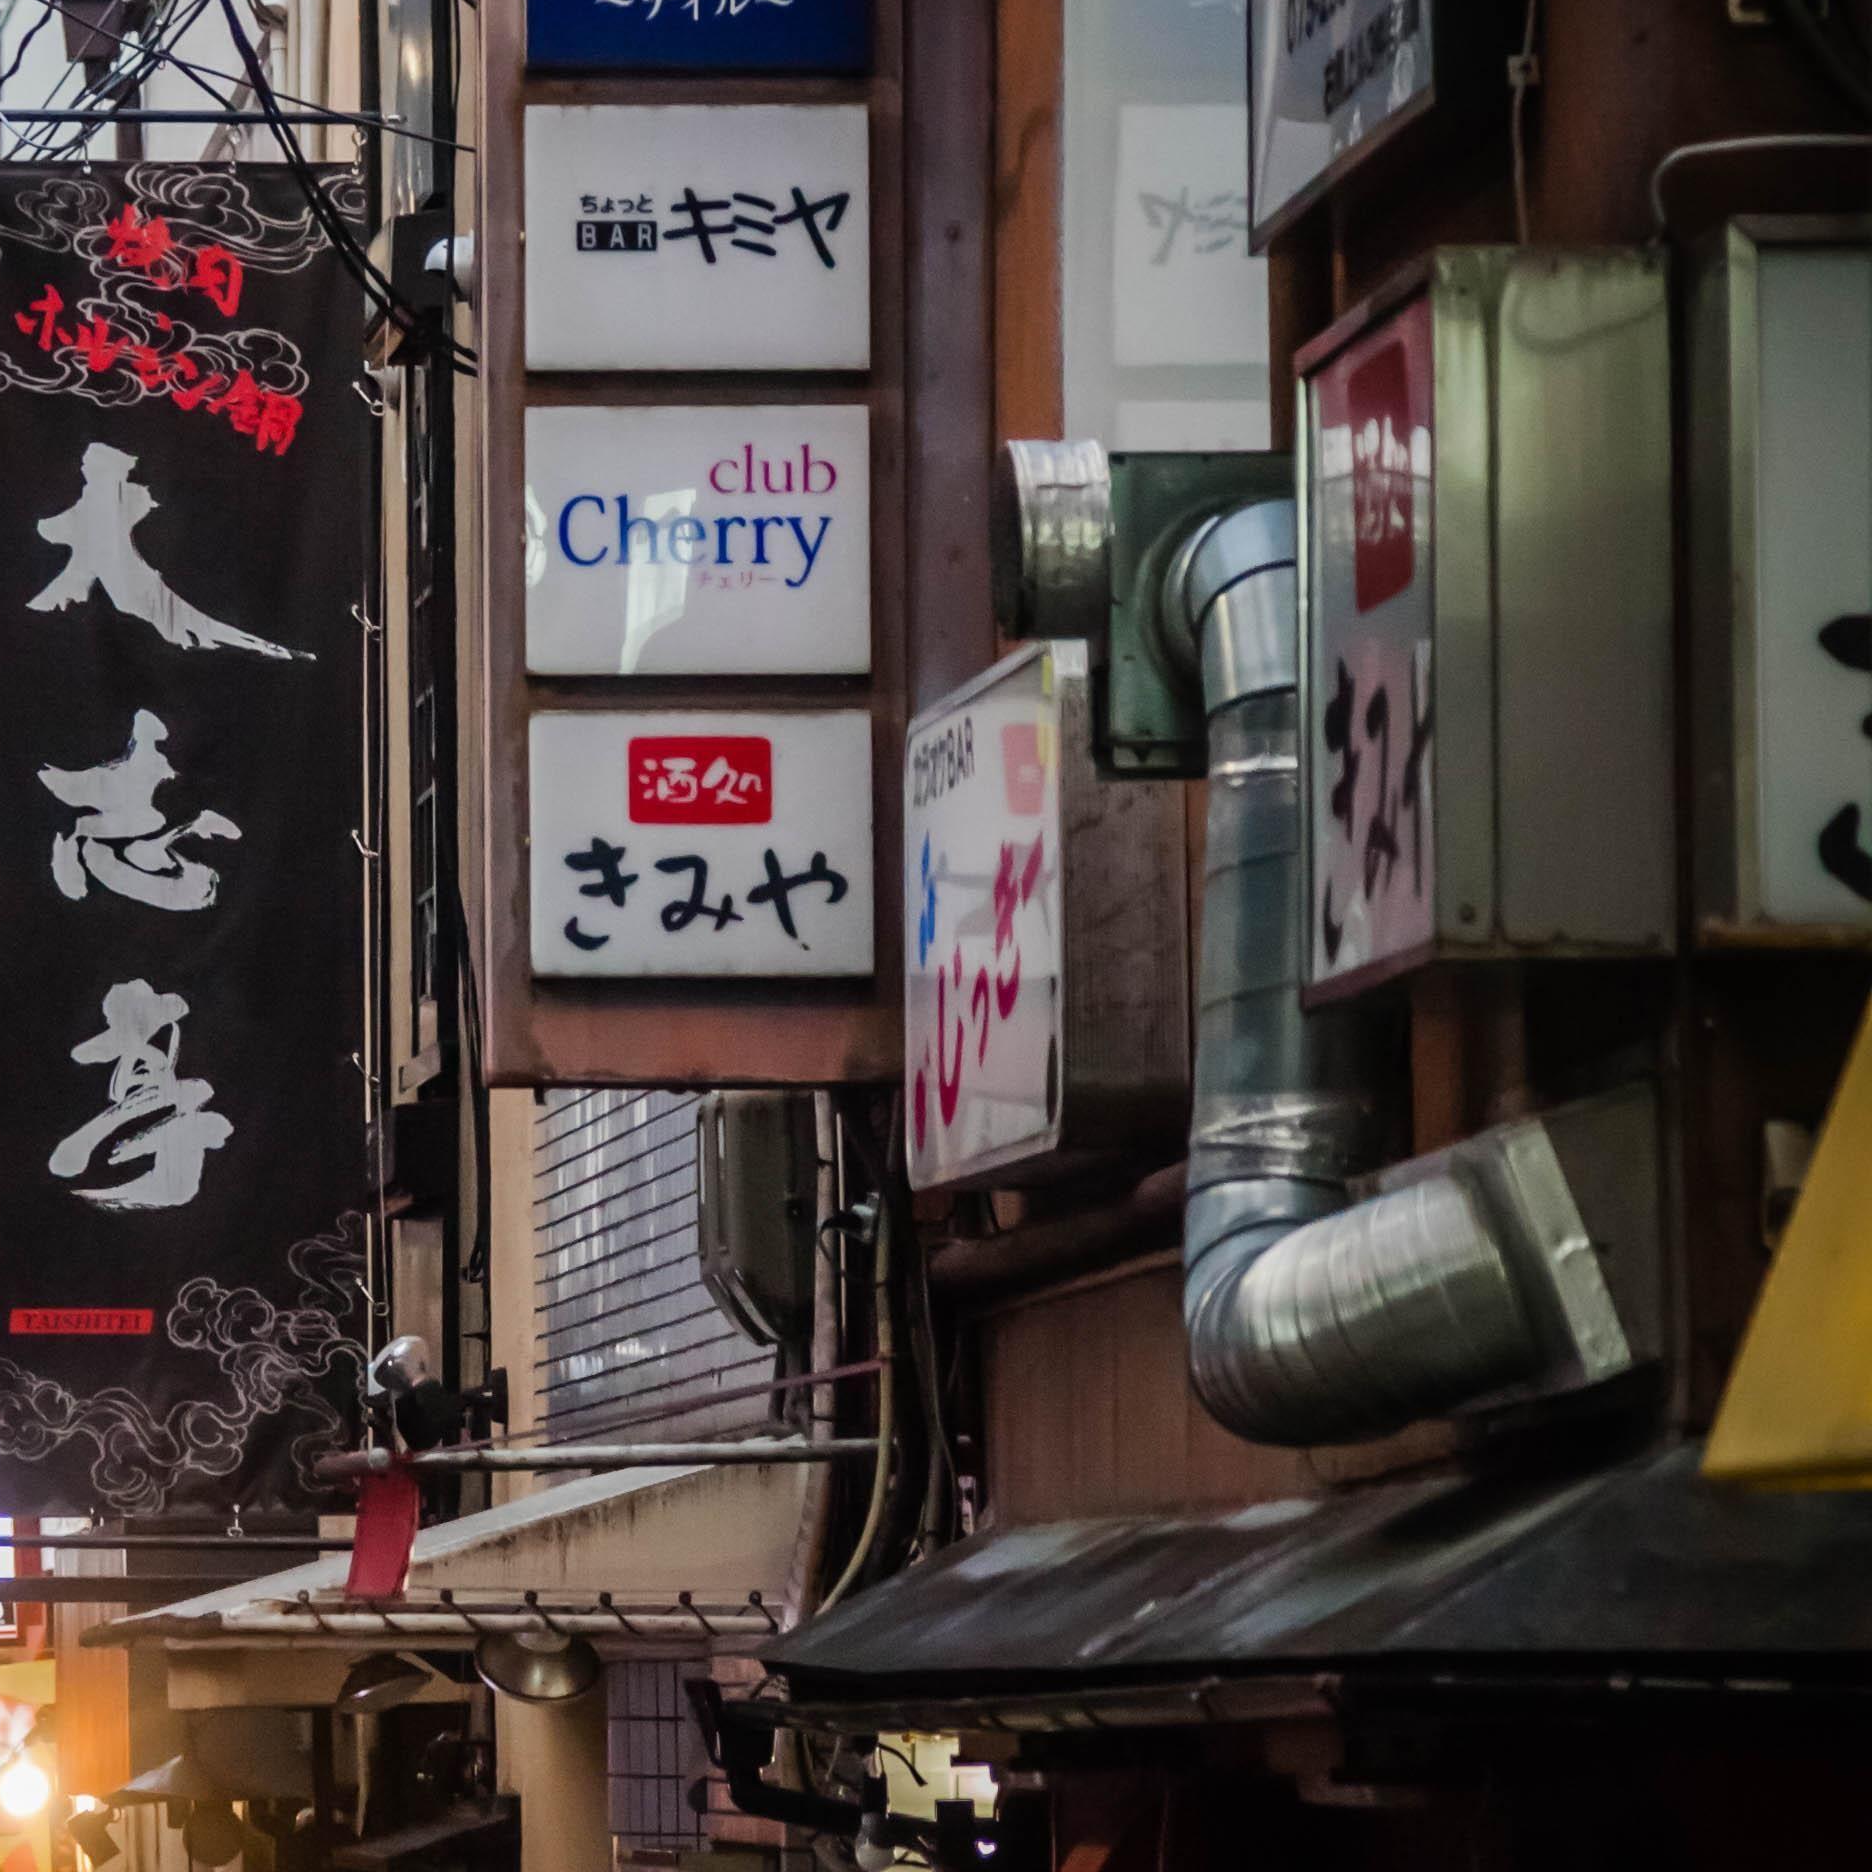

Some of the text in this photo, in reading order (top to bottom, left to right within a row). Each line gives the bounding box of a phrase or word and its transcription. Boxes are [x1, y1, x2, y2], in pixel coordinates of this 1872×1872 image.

[579, 193, 656, 215] ちょっと
[581, 224, 654, 251] BAR
[664, 186, 850, 268] キミヤ
[710, 443, 839, 498] club
[558, 493, 834, 589] Cherry
[562, 833, 852, 950] きみや
